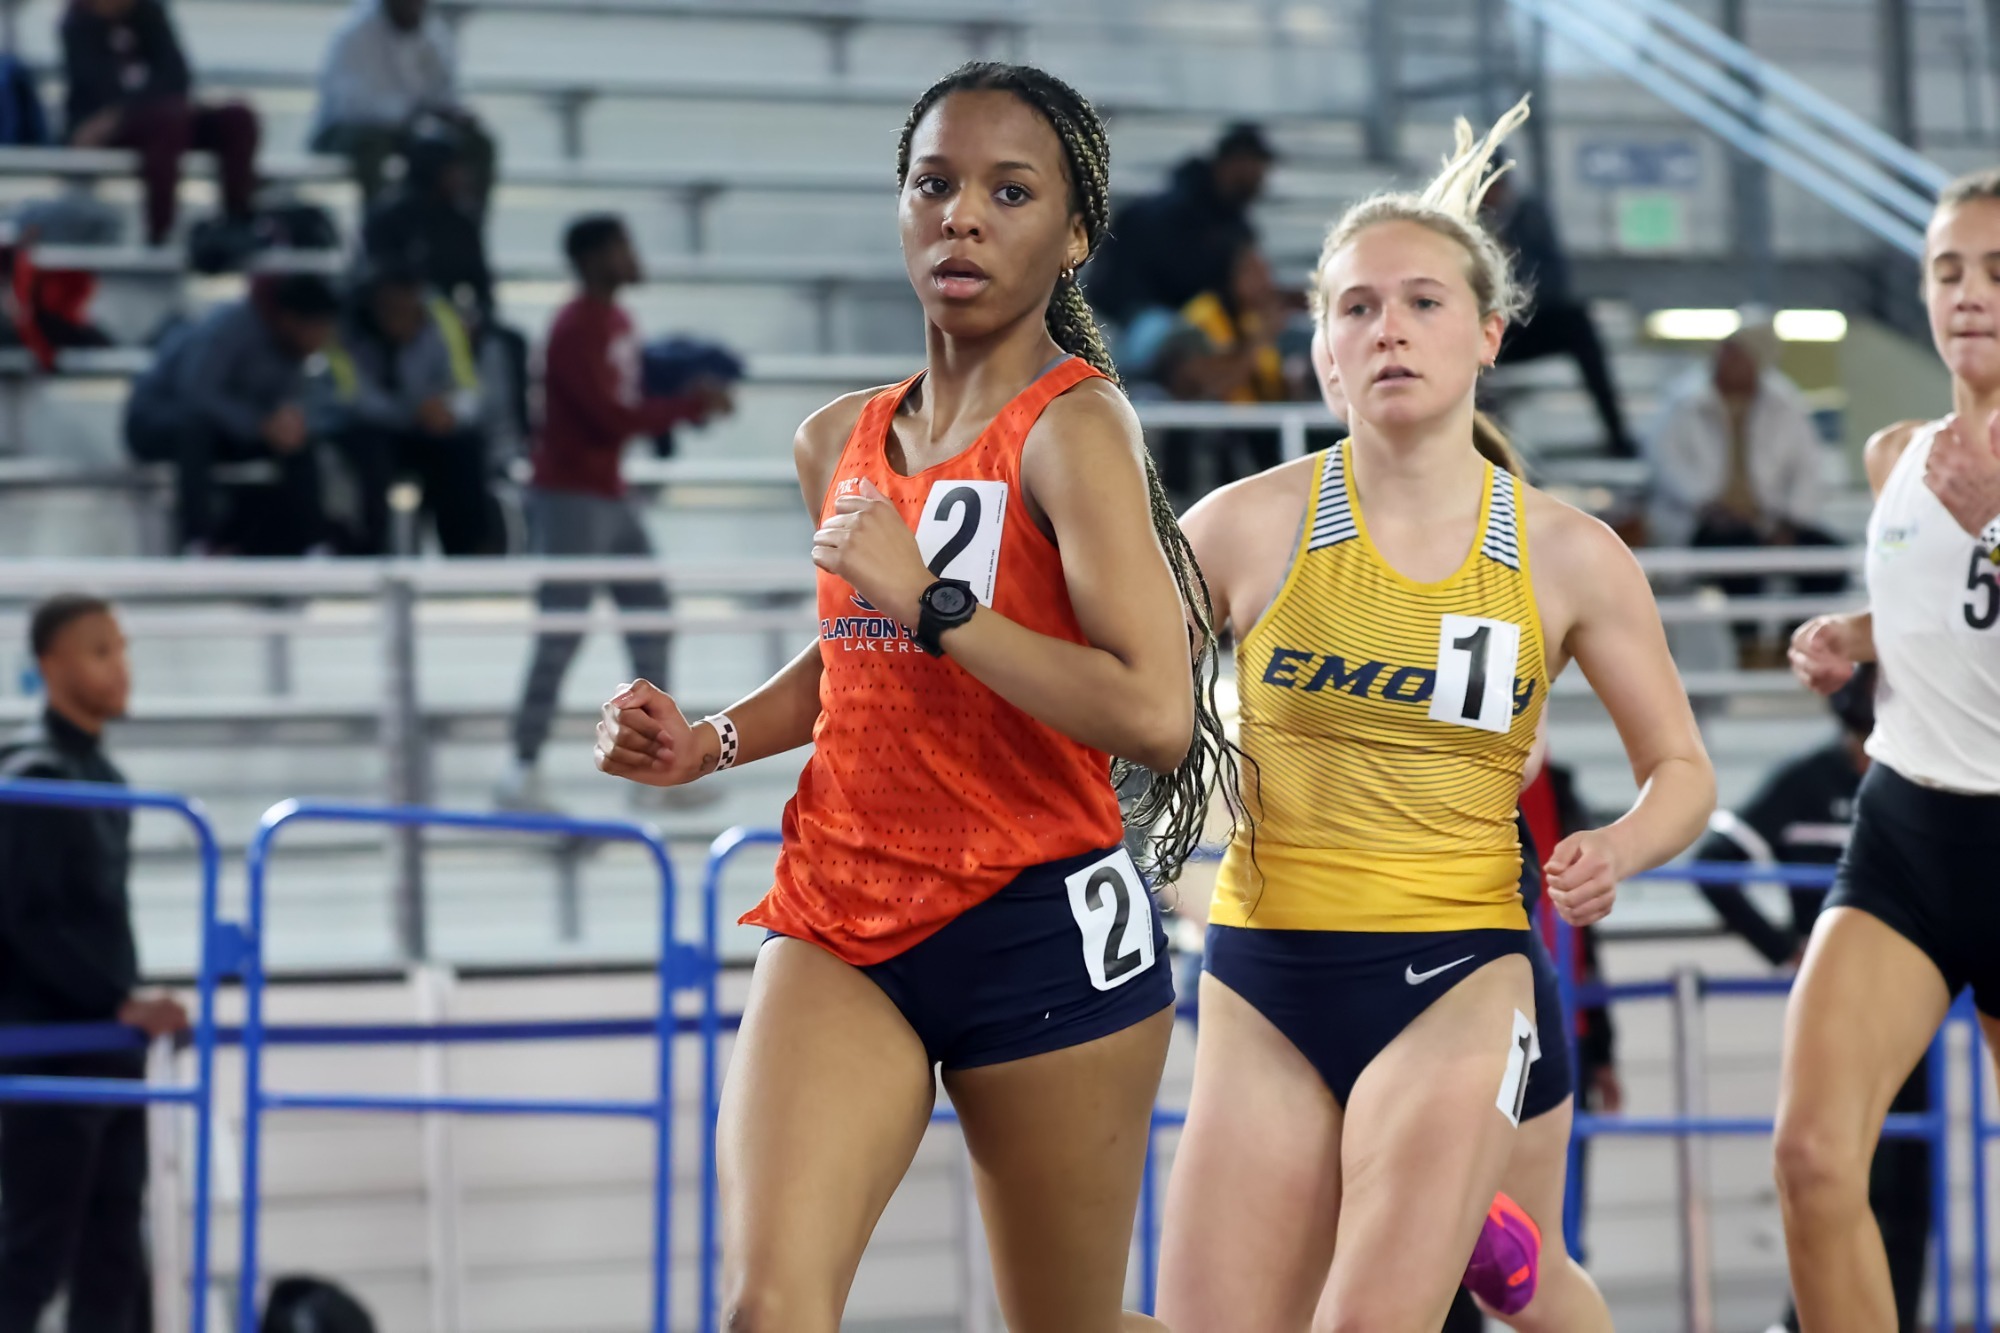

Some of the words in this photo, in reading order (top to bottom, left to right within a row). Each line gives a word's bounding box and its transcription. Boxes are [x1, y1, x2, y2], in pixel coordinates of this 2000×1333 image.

[927, 485, 982, 589] 2
[821, 616, 899, 641] CLAYTON
[1963, 545, 2000, 630] 5
[843, 640, 924, 653] LAKERS
[1262, 647, 1536, 716] EMOY
[1452, 625, 1491, 721] 1
[1084, 865, 1142, 983] 2
[1512, 1031, 1532, 1118] 1
